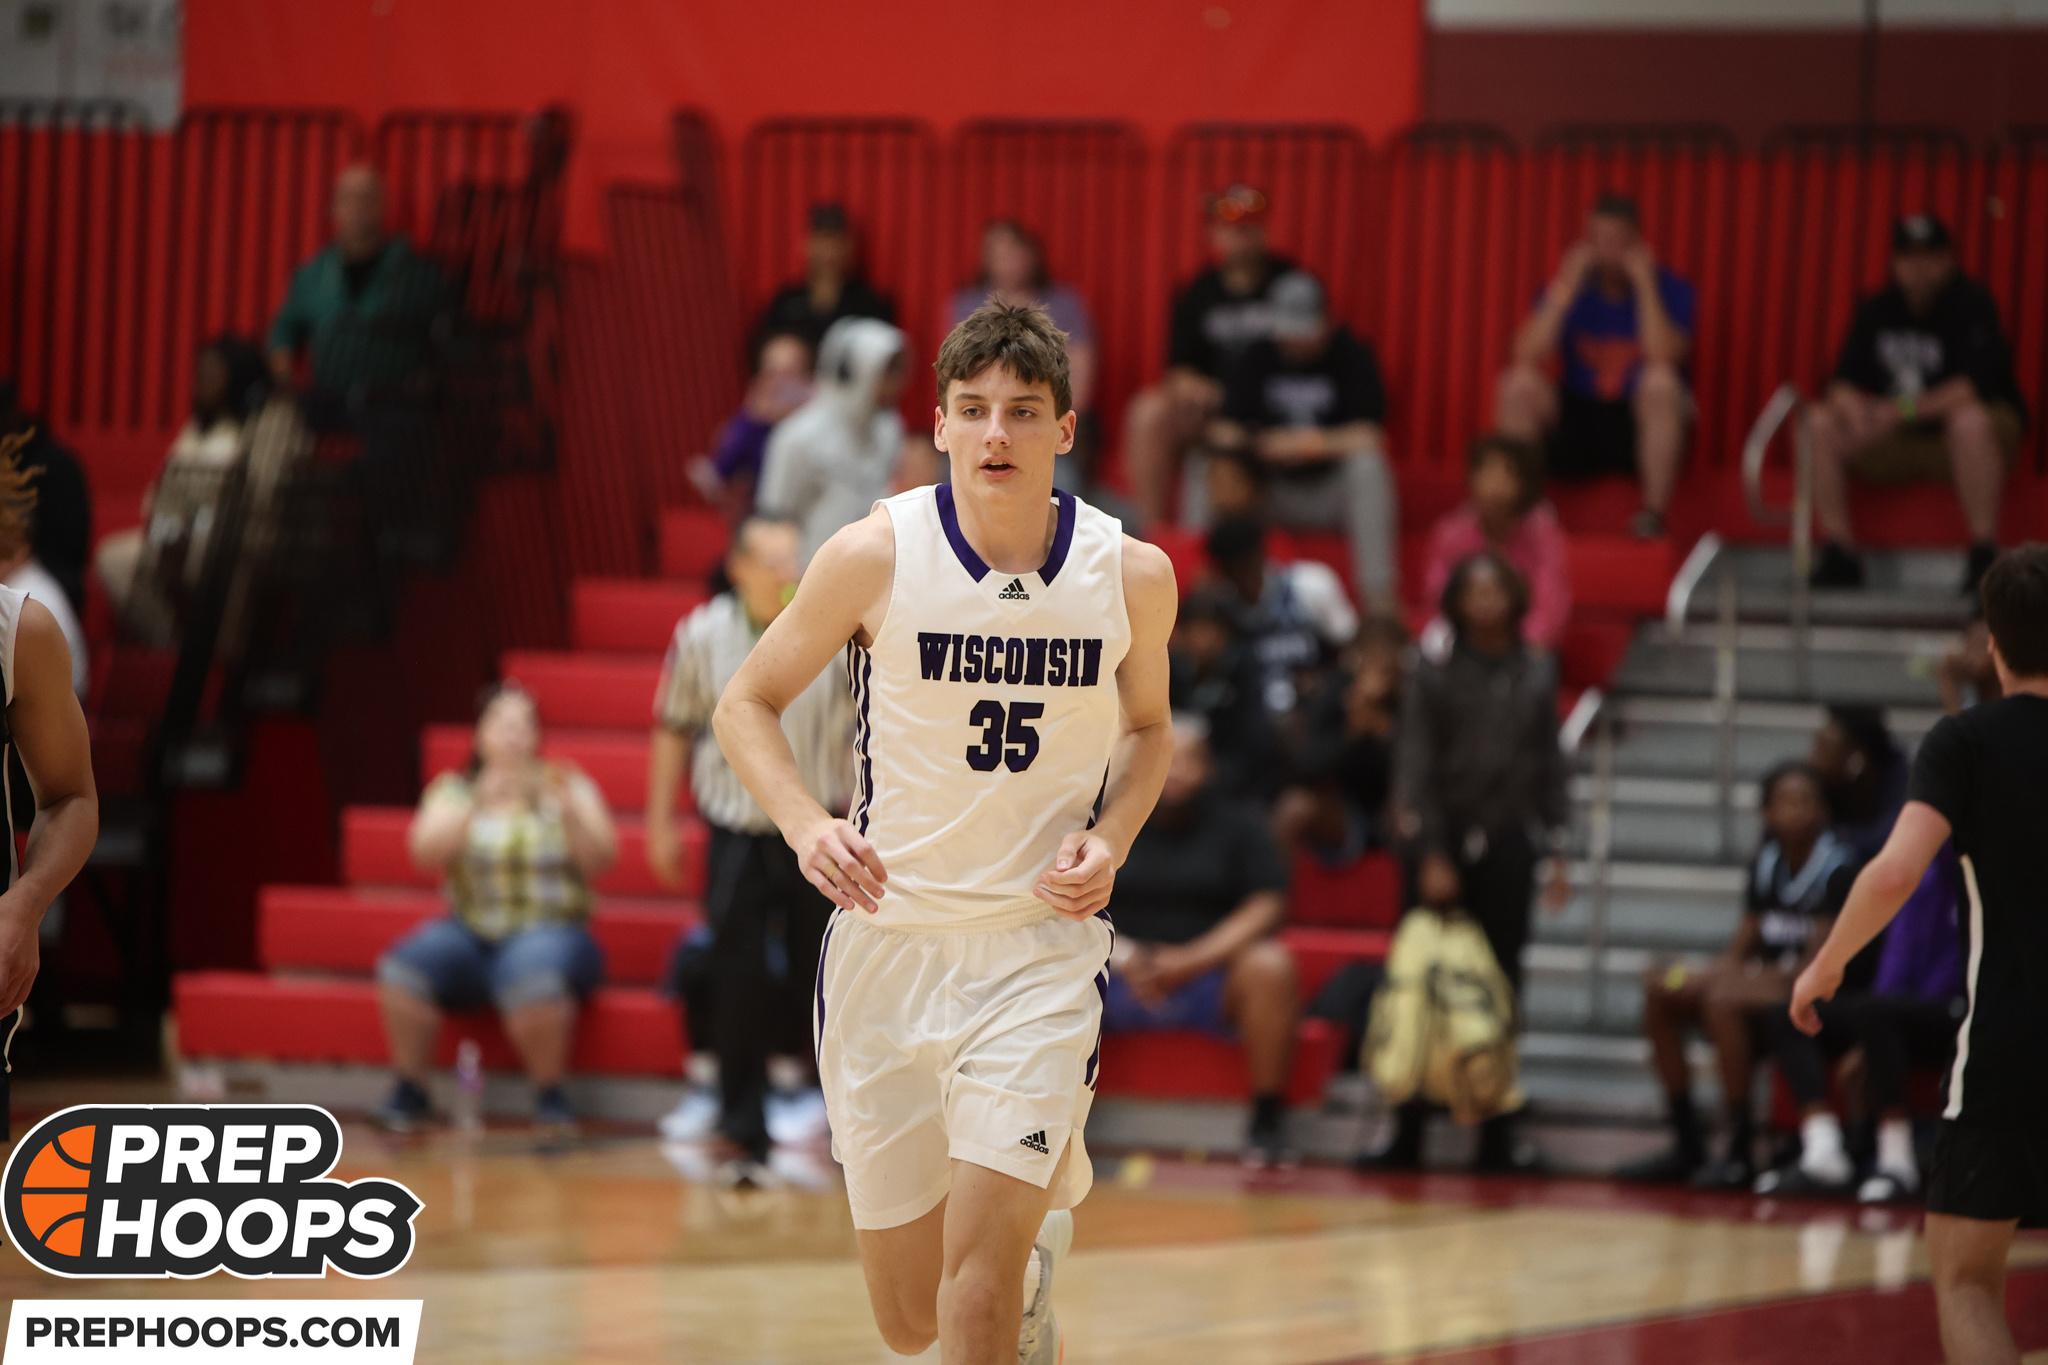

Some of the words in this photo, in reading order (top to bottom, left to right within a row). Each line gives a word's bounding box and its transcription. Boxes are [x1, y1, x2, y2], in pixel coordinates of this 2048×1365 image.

[998, 590, 1030, 600] adidas
[917, 631, 1103, 687] WISCONSIN
[966, 700, 1045, 773] 35
[1019, 1138, 1050, 1155] adidas
